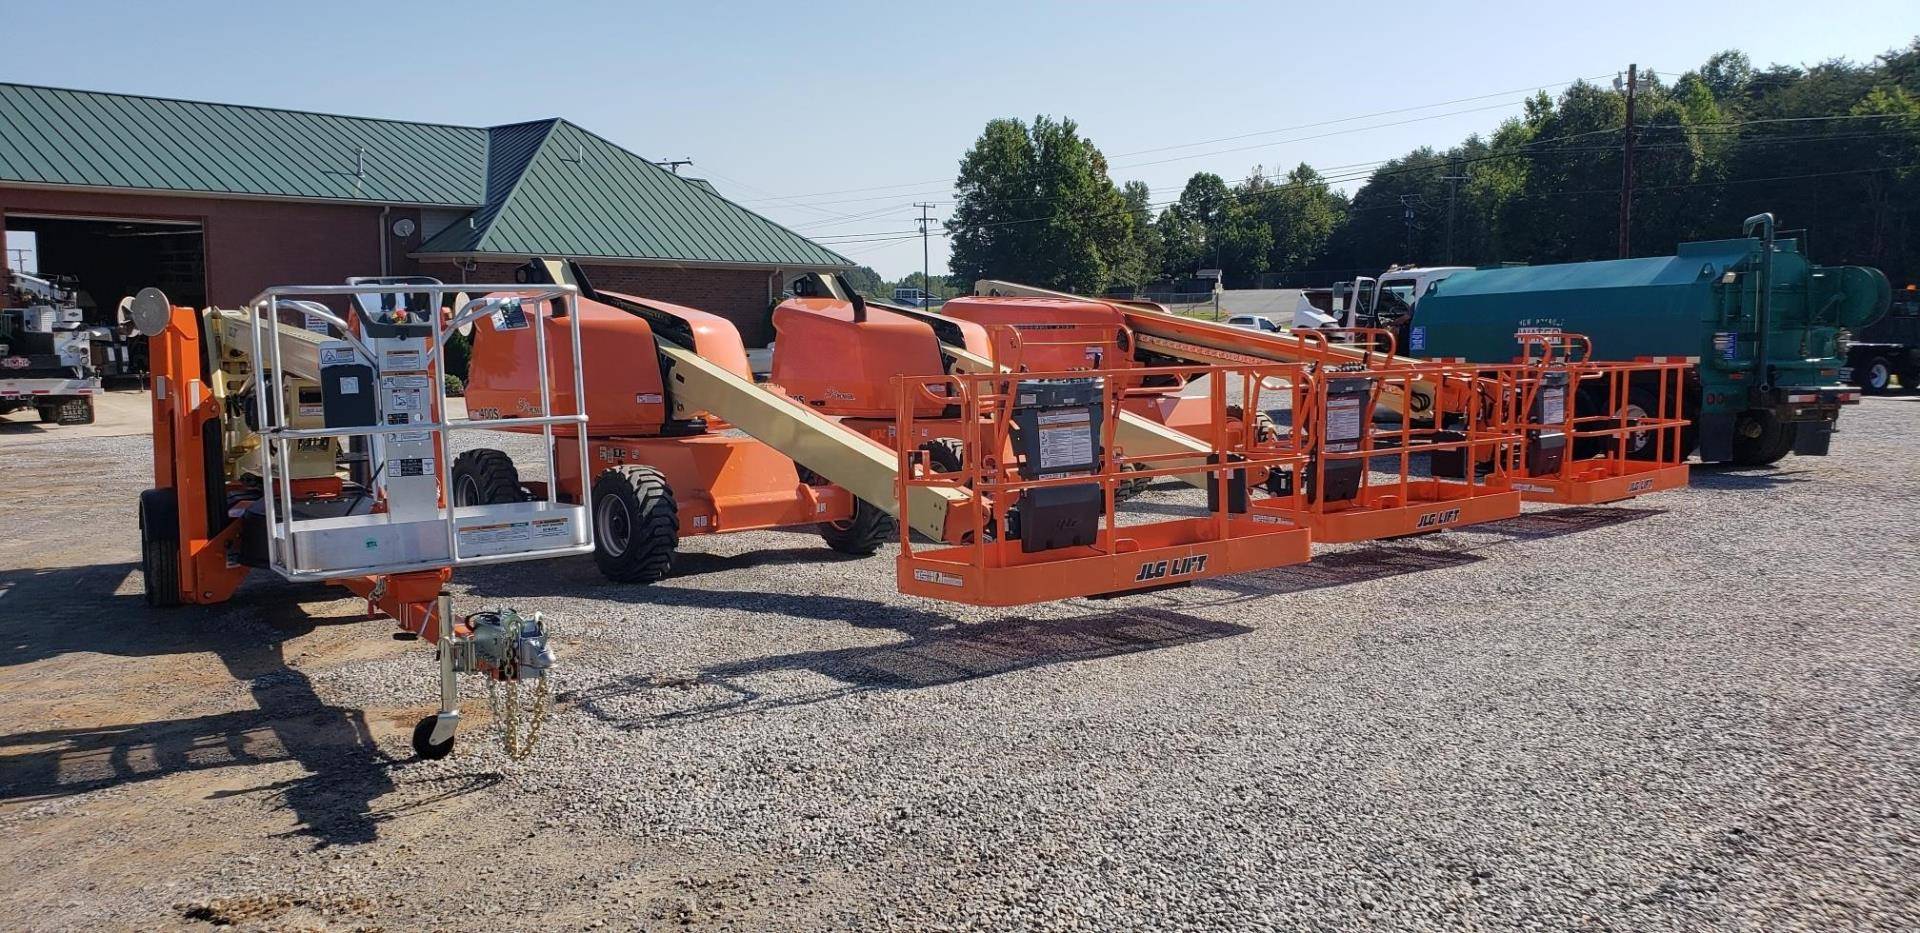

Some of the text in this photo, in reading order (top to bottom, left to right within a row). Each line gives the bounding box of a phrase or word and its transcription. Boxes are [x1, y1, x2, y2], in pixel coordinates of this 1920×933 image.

[1416, 508, 1460, 529] JLG LIFT
[1135, 554, 1209, 582] JLG LIFT
